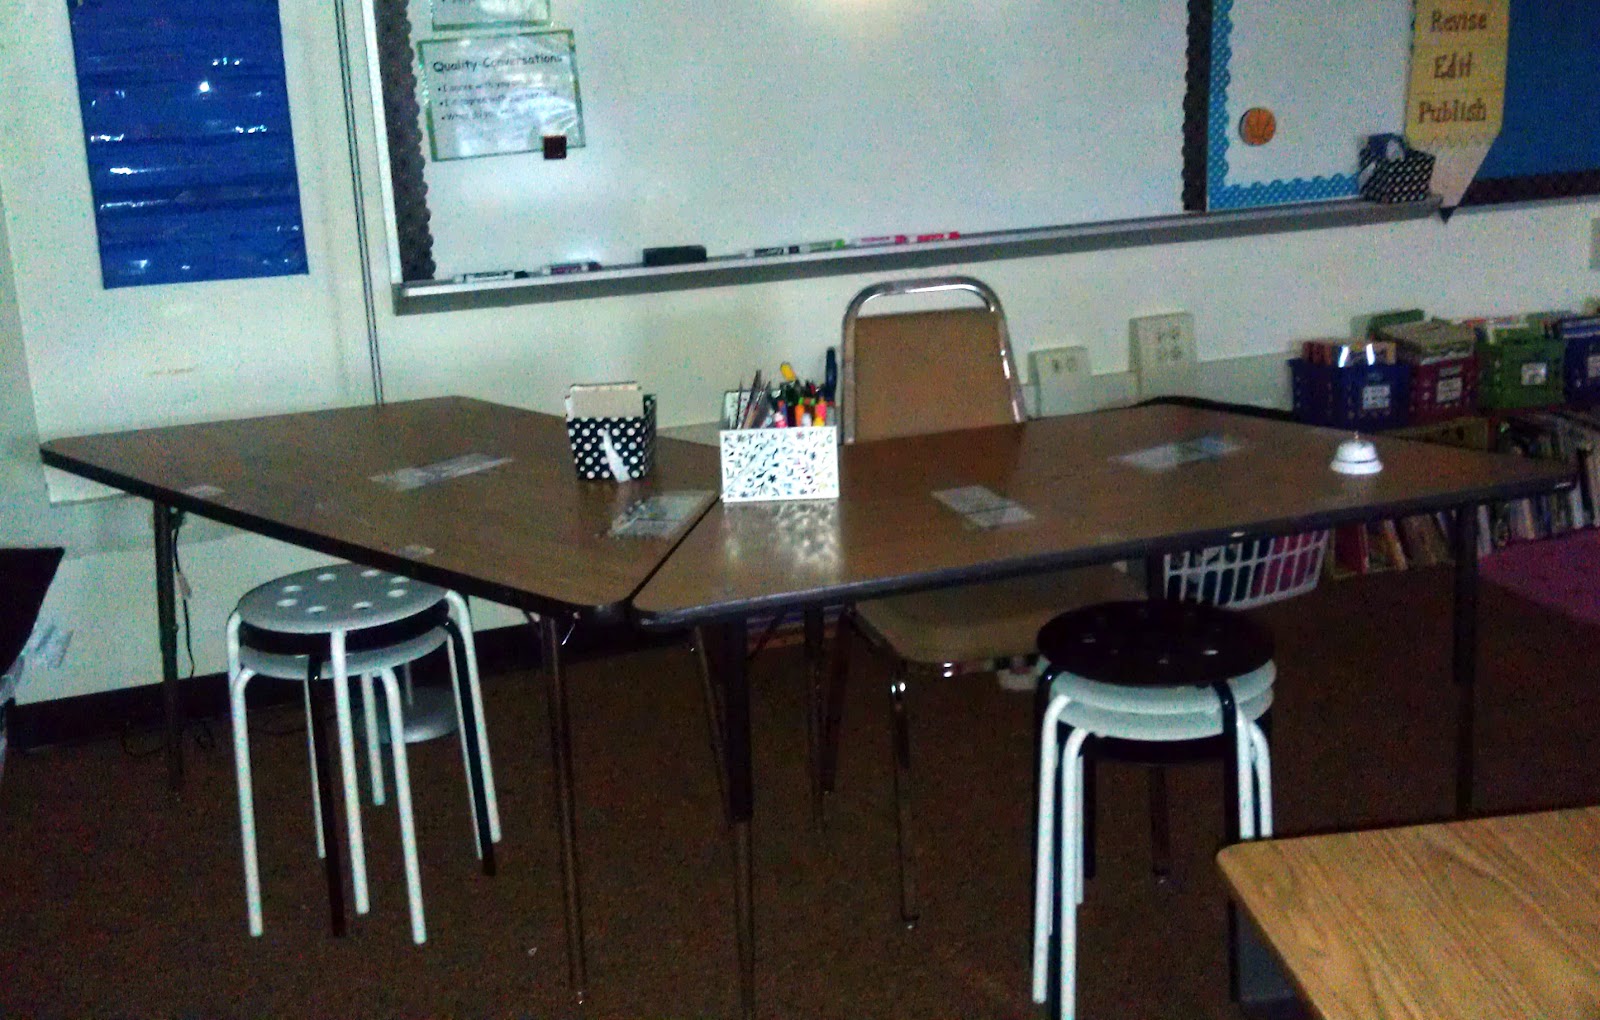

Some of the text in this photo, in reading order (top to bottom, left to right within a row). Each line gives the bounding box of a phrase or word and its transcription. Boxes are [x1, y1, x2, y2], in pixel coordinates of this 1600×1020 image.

[1431, 10, 1487, 31] Revise
[432, 60, 478, 73] Quality
[1434, 51, 1472, 78] Edit
[1418, 97, 1487, 123] Publish
